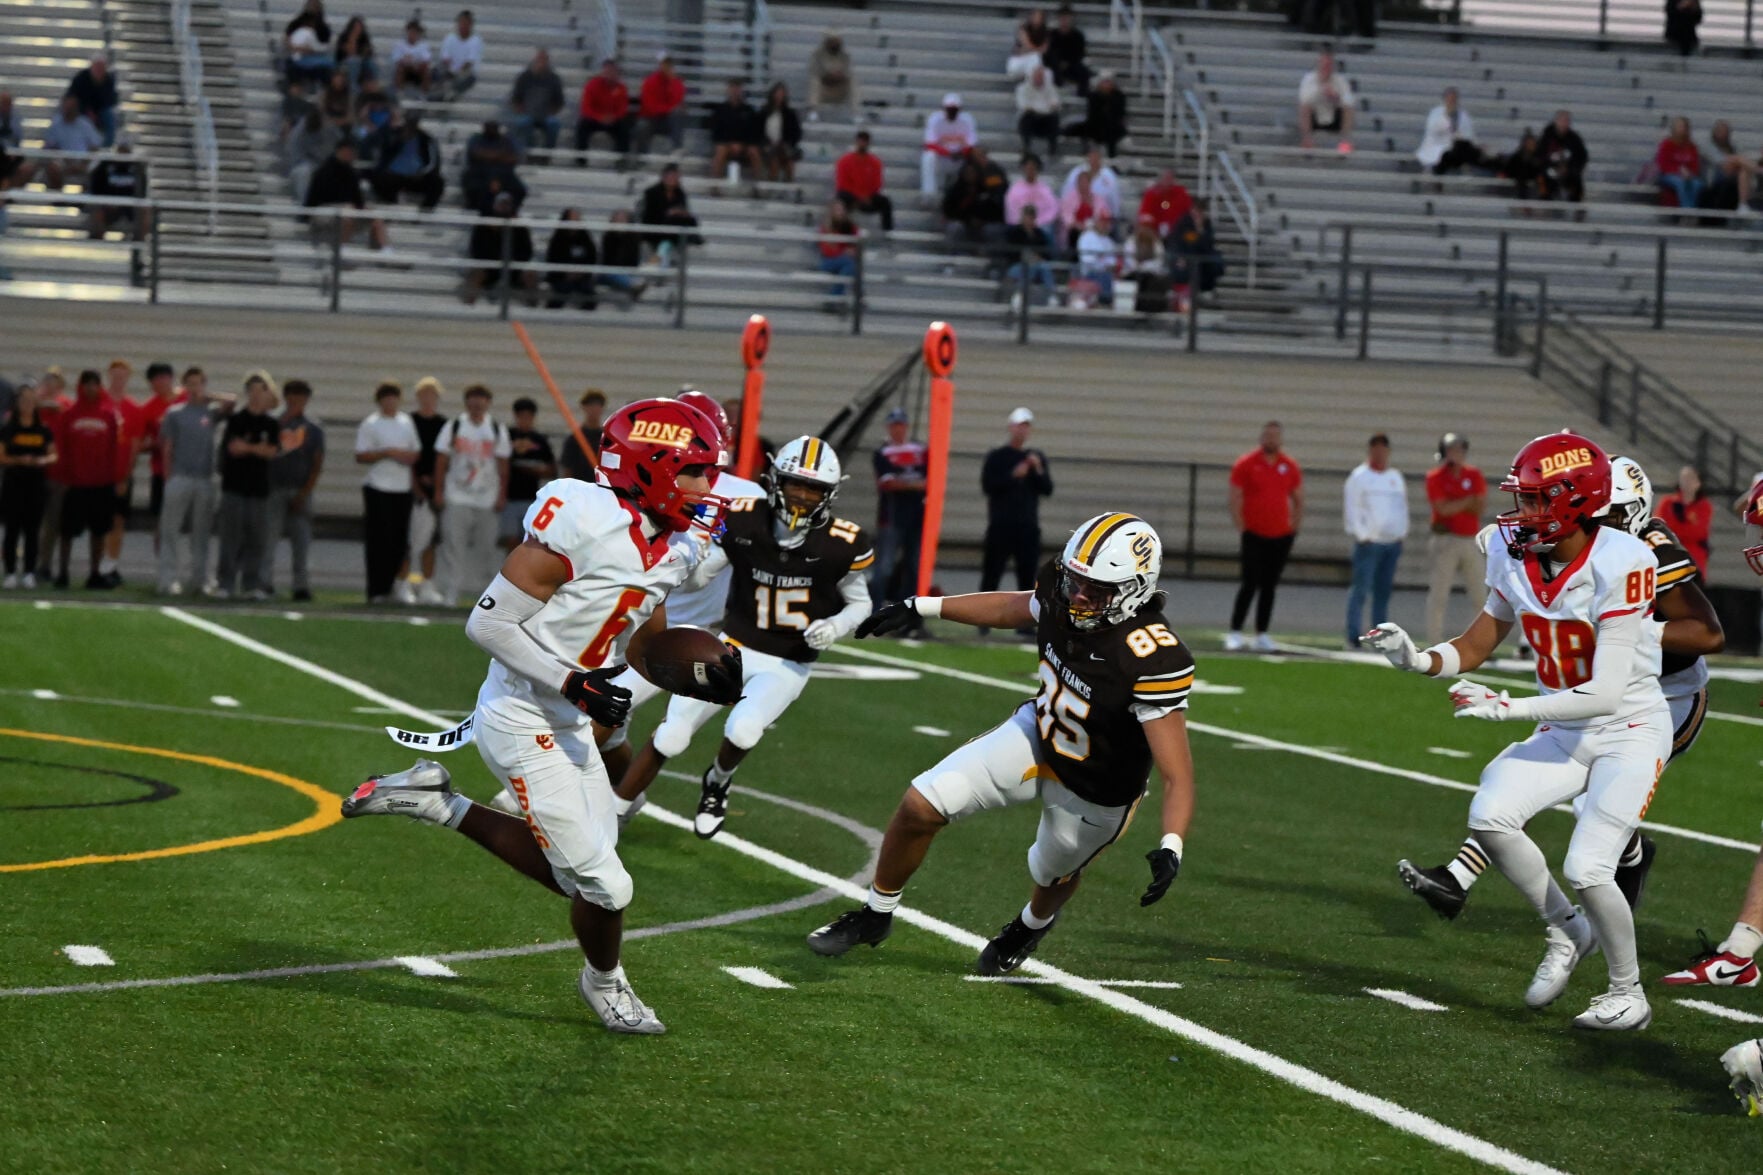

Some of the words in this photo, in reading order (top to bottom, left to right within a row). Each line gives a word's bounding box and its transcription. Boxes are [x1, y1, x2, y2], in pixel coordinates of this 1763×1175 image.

[631, 420, 693, 444] DONS
[1540, 447, 1592, 474] DONS
[532, 496, 565, 532] 6
[730, 496, 758, 512] 5
[829, 517, 861, 544] 15
[1643, 529, 1674, 550] 2
[752, 568, 774, 585] SAINT
[777, 576, 813, 588] FRANCIS
[1626, 566, 1655, 605] 88
[755, 586, 809, 630] 15
[577, 587, 648, 670] 6
[1126, 623, 1179, 658] 85
[1521, 611, 1597, 691] 88
[1045, 642, 1062, 671] SAINT
[1061, 666, 1093, 700] FRANCIS
[397, 730, 430, 744] BE
